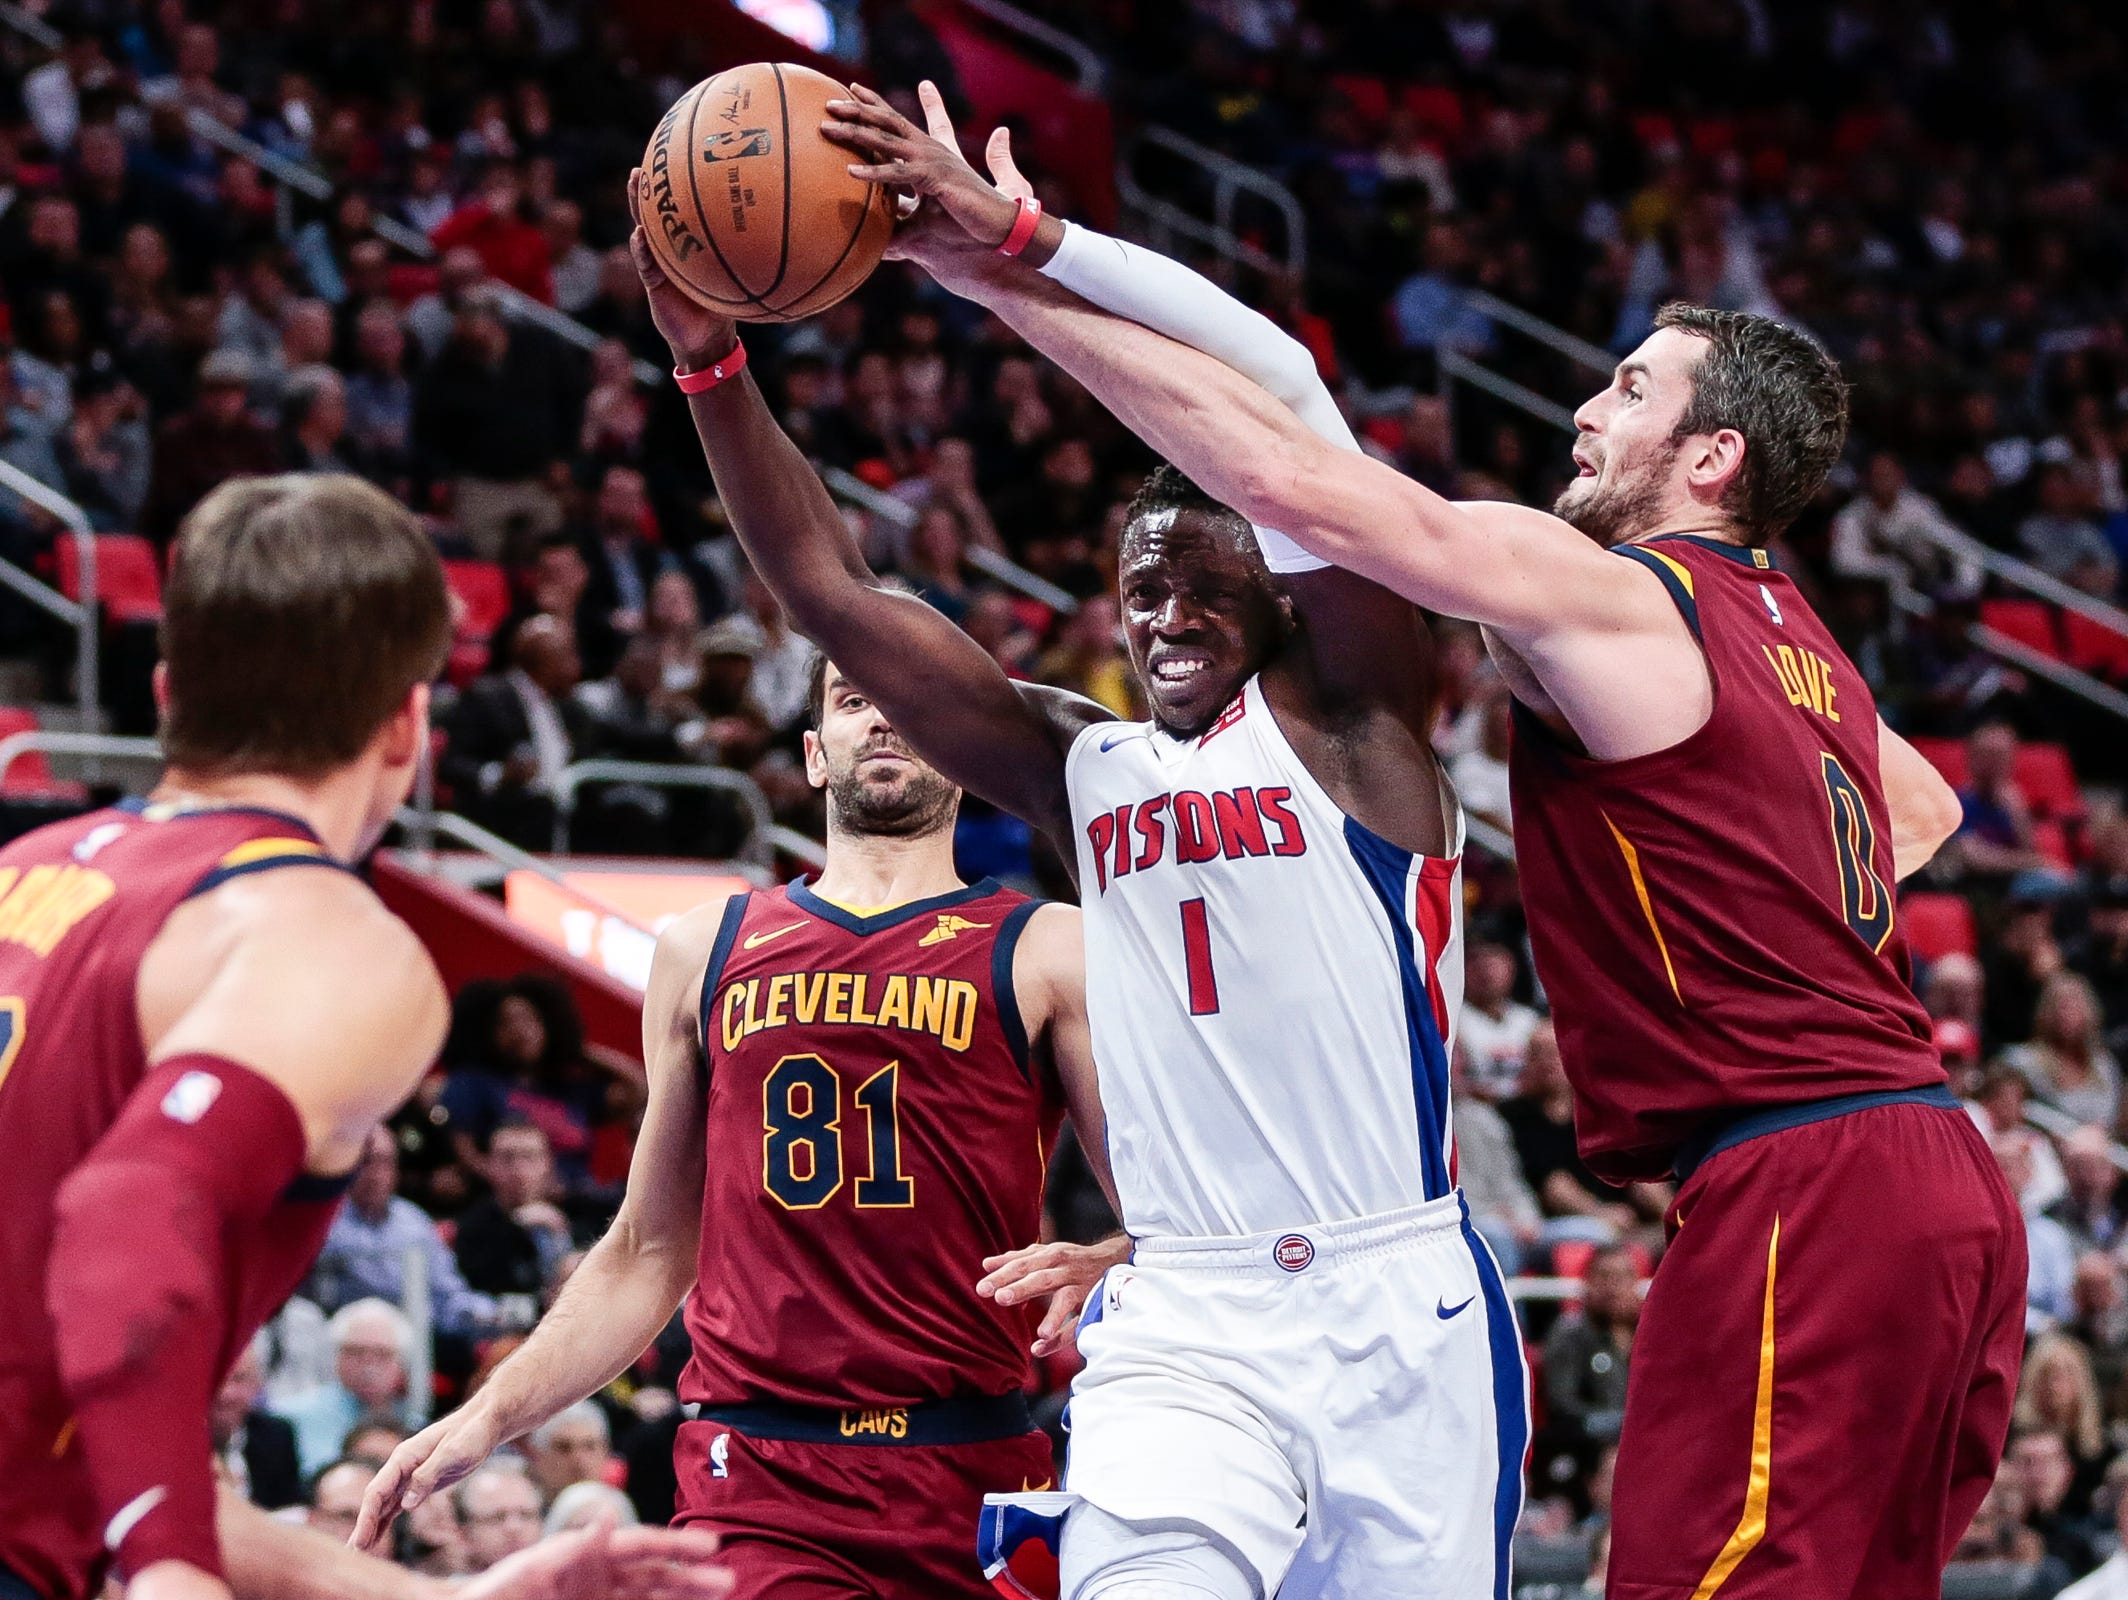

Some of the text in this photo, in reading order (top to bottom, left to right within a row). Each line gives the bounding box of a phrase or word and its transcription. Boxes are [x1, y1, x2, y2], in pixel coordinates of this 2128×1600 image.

[652, 94, 704, 262] SPALDIN
[728, 166, 740, 183] BALL
[730, 185, 743, 203] GAME
[1761, 644, 1841, 723] LOVE
[1820, 751, 1893, 956] 0
[1179, 896, 1221, 1016] 1
[721, 972, 979, 1053] CLEVELAND
[763, 1053, 914, 1211] 81
[840, 1408, 908, 1438] CAVS
